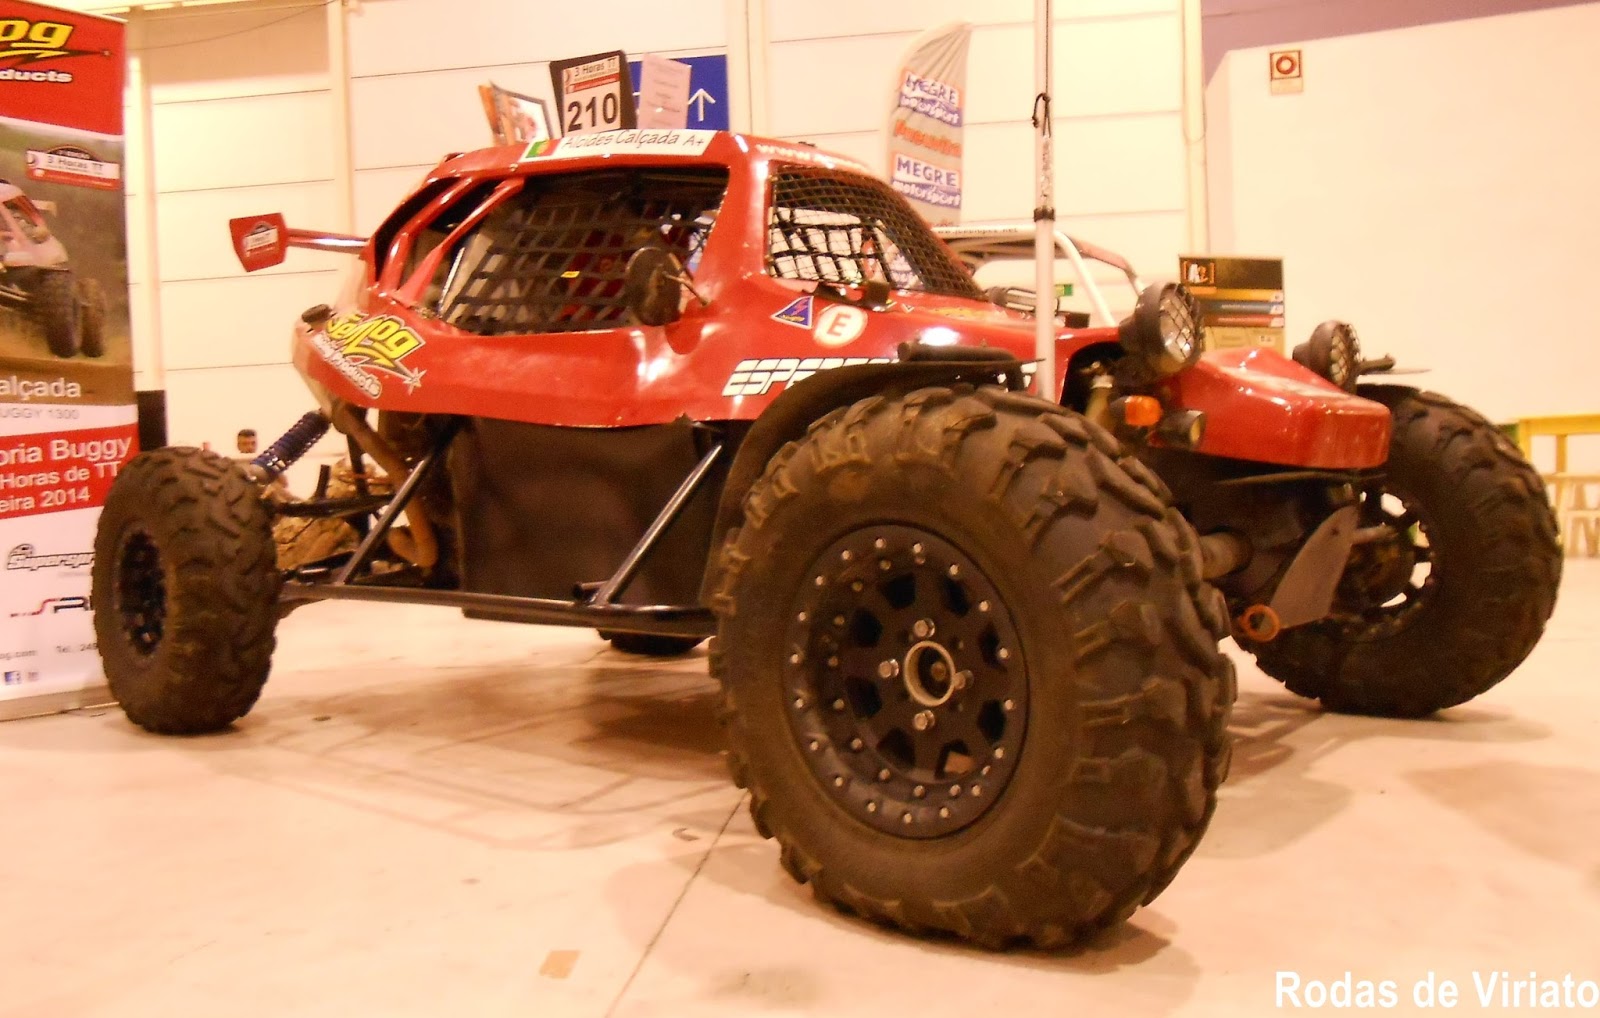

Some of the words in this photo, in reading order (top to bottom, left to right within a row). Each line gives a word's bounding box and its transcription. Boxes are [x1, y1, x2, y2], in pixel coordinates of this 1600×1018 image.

[574, 66, 581, 77] 3
[582, 62, 605, 74] Horas
[608, 57, 617, 68] TT
[567, 92, 619, 132] 210
[900, 96, 960, 125] moorsport
[562, 130, 612, 149] Alcides
[616, 129, 680, 149] Calçada
[684, 131, 705, 147] A+
[58, 157, 88, 170] Horas
[896, 157, 957, 187] MEGRE
[826, 312, 850, 337] E
[48, 408, 80, 419] 1300
[50, 437, 132, 462] Buggy
[0, 471, 60, 490] Horas
[64, 466, 91, 483] de
[93, 460, 122, 479] TT
[40, 486, 91, 508] 2014
